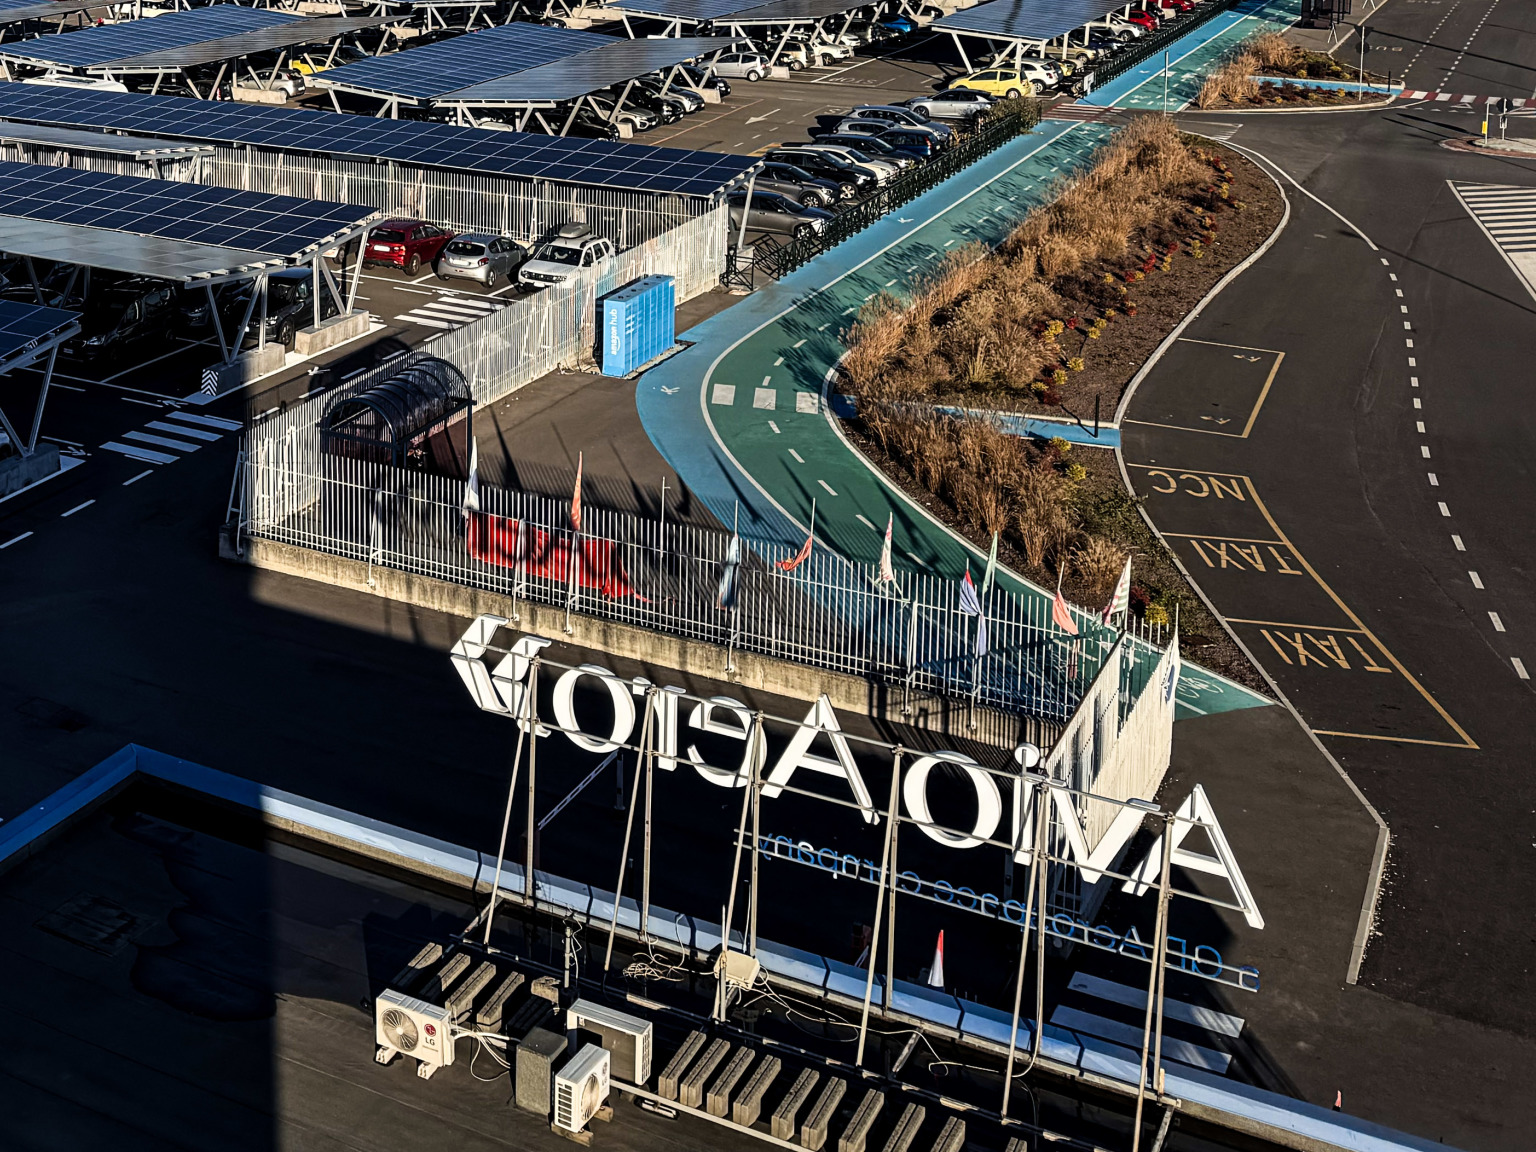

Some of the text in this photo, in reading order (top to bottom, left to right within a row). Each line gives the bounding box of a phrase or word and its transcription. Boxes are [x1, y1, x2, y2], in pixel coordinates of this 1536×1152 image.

[609, 308, 618, 356] amazon hub
[1147, 470, 1246, 501] NCC
[1190, 539, 1303, 576] TAXI
[1260, 629, 1393, 673] TAXI
[425, 1036, 436, 1046] LG
